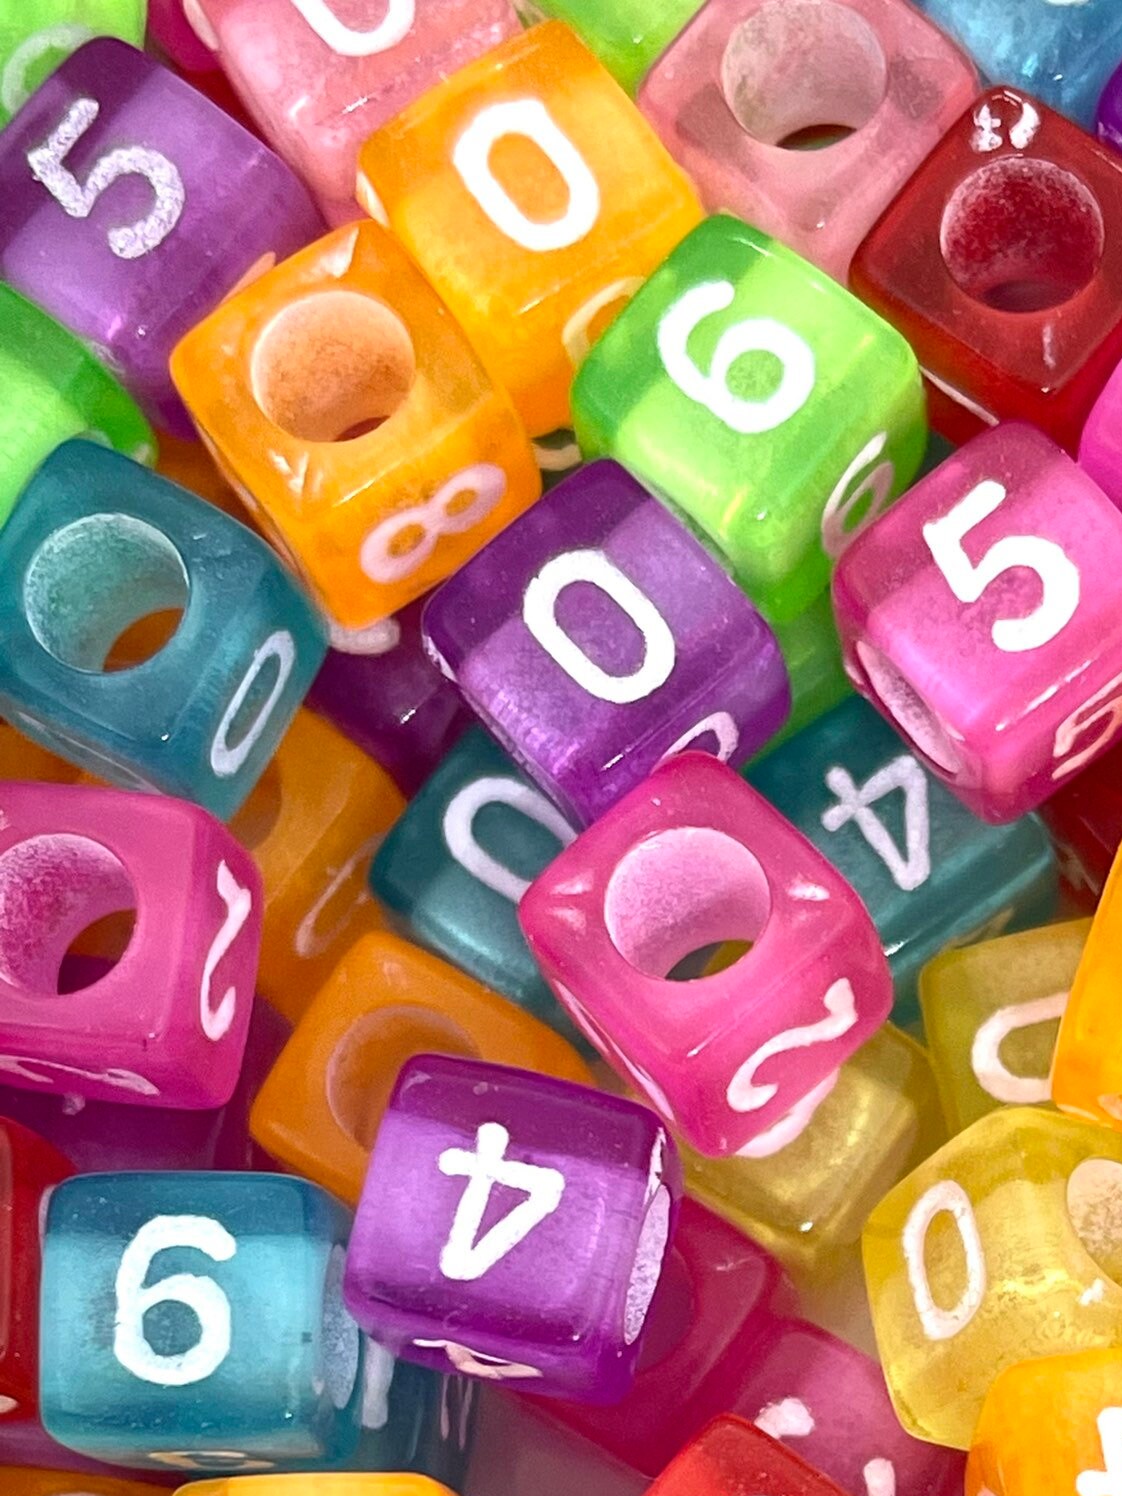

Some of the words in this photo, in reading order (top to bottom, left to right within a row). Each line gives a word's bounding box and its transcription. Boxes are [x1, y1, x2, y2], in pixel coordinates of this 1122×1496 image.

[28, 99, 184, 258] 5
[452, 96, 600, 251] 0
[658, 280, 815, 433] 6
[360, 464, 505, 583] 8
[923, 481, 1080, 651] 5
[210, 631, 294, 777] 0
[524, 550, 675, 703] 0
[822, 755, 930, 891] 4
[438, 1123, 565, 1279] 4
[902, 1181, 986, 1340] 0
[113, 1216, 236, 1385] 6
